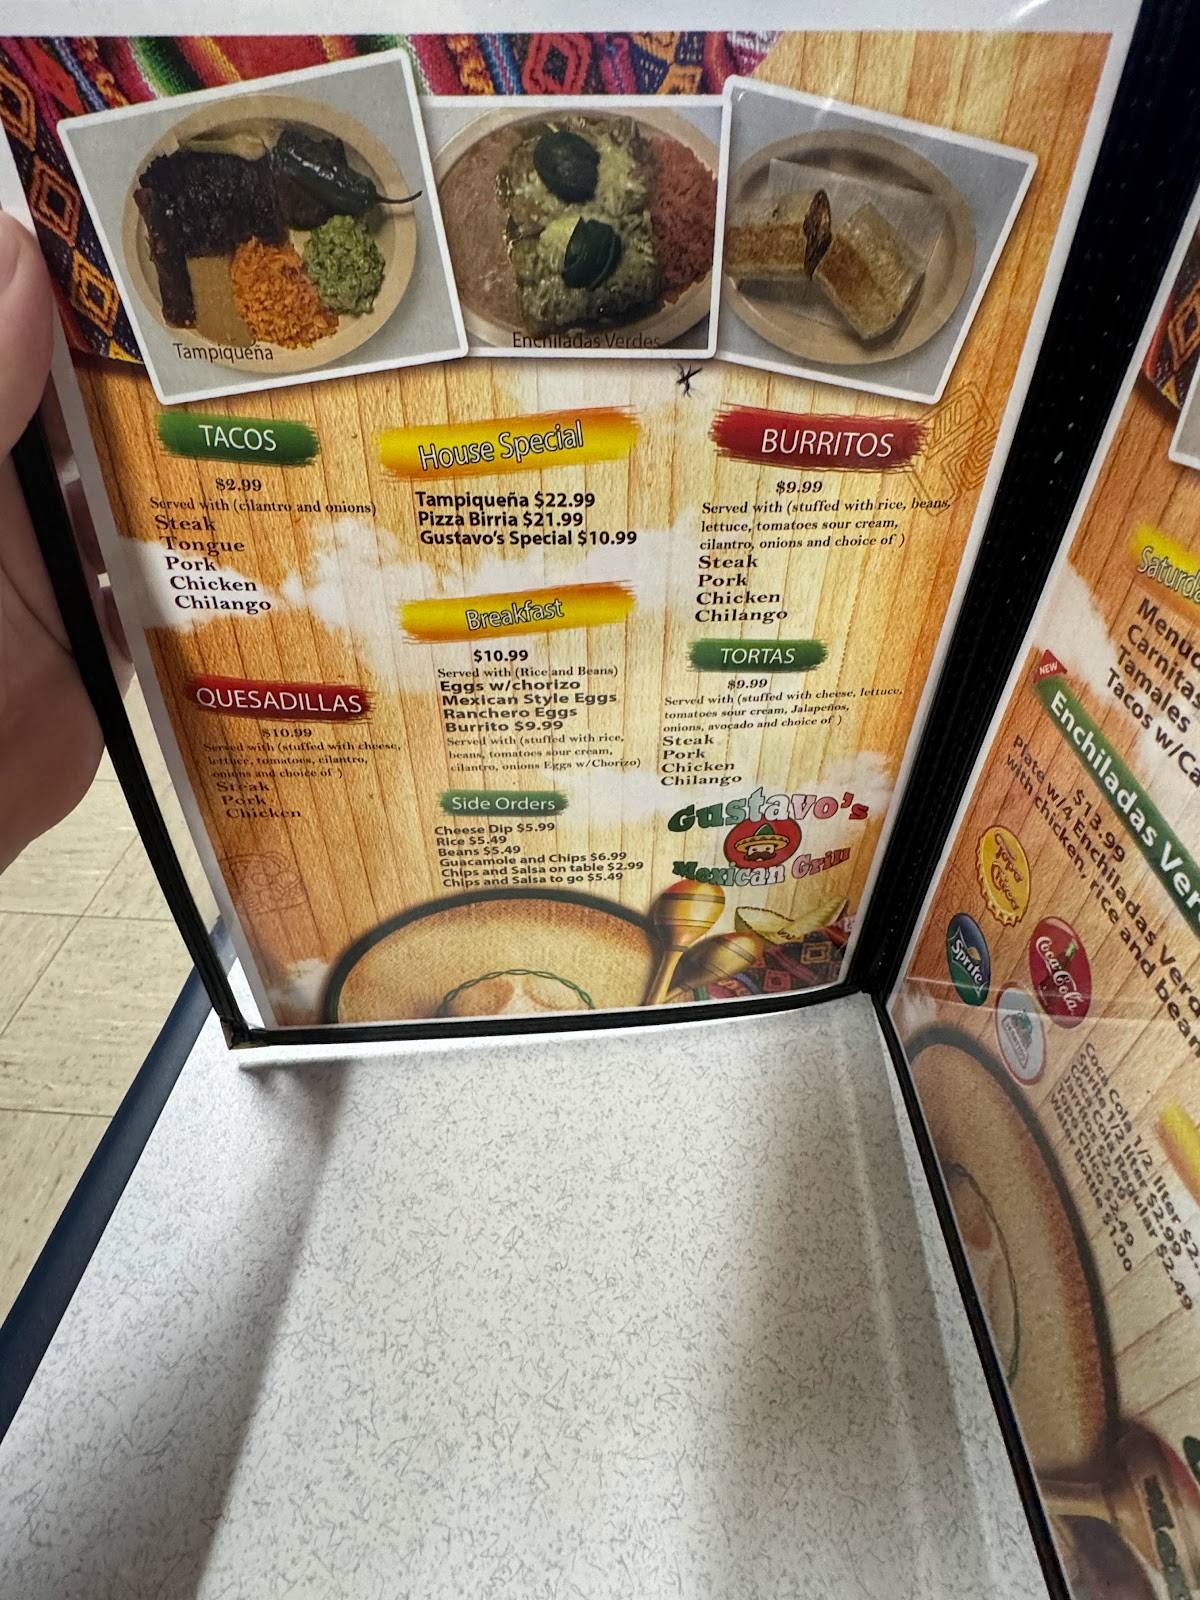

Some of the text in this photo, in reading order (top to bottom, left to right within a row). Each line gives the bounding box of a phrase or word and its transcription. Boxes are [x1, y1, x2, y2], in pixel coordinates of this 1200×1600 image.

[172, 343, 273, 363] Tampiqueña
[198, 424, 277, 452] TACOS
[418, 419, 584, 471] House Special
[761, 428, 894, 458] BURRITOS
[215, 478, 262, 492] $2.99
[776, 481, 823, 494] $9.99
[150, 496, 377, 517] Served with (cilantro and onions)
[415, 491, 595, 511] Tampiqueña $22.99
[702, 497, 951, 516] Served with (stuffed with rice, beans,
[154, 514, 217, 532] Steak
[418, 511, 583, 528] Pizza Birria $21.99
[701, 519, 898, 534] lettuce, tomatoes sour cream,
[159, 535, 245, 557] Tongue
[510, 530, 573, 549] Special
[578, 530, 637, 547] $10.99
[700, 534, 896, 551] cilantro, onions and choice of
[165, 556, 217, 572] Pork
[698, 554, 758, 569] Steak
[170, 575, 257, 592] Chicken
[698, 573, 748, 587] Pork
[174, 595, 272, 615] Chilango
[696, 592, 781, 605] Chicken
[465, 599, 565, 631] Breakfast
[695, 609, 788, 624] Chilango
[473, 649, 529, 663] $10.99
[720, 648, 796, 664] TORTAS
[437, 665, 618, 679] Served with (Rice and Beans)
[1039, 661, 1058, 675] NEW
[1127, 624, 1200, 710] Carnitas
[440, 679, 581, 694] Eggs w/chorizo
[727, 678, 768, 690] $9.99
[1117, 645, 1191, 733] Tamales
[196, 687, 362, 713] QUESADILLAS
[442, 692, 617, 707] Mexican Style Eggs
[664, 689, 856, 706] Served with (stuffed with cheese,
[1107, 667, 1153, 730] Tacos
[444, 707, 578, 720] Ranchero Eggs
[664, 709, 718, 720] tomatoes
[721, 708, 746, 718] sour
[262, 728, 312, 738] $10.99
[445, 720, 564, 733] Burrito $9.99
[663, 716, 817, 733] onions, avocado and choice
[663, 735, 715, 747] Steak
[663, 748, 706, 760] Pork
[661, 761, 735, 773] Chicken
[1050, 690, 1158, 847] Enchiladas
[216, 781, 270, 793] Steak
[660, 774, 742, 787] Chilango
[222, 794, 267, 806] Pork
[451, 796, 556, 811] Side Orders
[226, 807, 302, 819] Chicken
[434, 822, 555, 836] Cheese Dip $5.99
[1073, 789, 1125, 863] $13.99
[436, 835, 507, 847] Rice $5.49
[1013, 734, 1045, 784] Plate
[1047, 783, 1073, 821] w/4
[1073, 819, 1156, 946] Enchiladas
[438, 845, 521, 857] Beans $5.49
[440, 851, 627, 868] Guacamole and Chips $6.99
[441, 861, 644, 878] Chips and Salsa on table $2.99
[672, 847, 851, 887] Mexican Grill
[1007, 754, 1033, 796] with
[1034, 796, 1086, 879] chicken,
[1090, 880, 1119, 925] rice
[1120, 927, 1156, 979] and
[443, 872, 623, 888] Chips and Salsa to go $5.49
[951, 938, 984, 985] Sprite
[1063, 1075, 1126, 1200] Jarritos $2.49
[1086, 1043, 1181, 1224] Coca Cola 1/2 liter
[1080, 1054, 1182, 1256] Sprite 1/2 liter $2.99
[1058, 1082, 1135, 1247] Topo Chico $2.49
[1051, 1093, 1133, 1272] Water Bottle $1.00
[1071, 1064, 1193, 1310] Coca Cola Regular $2.49
